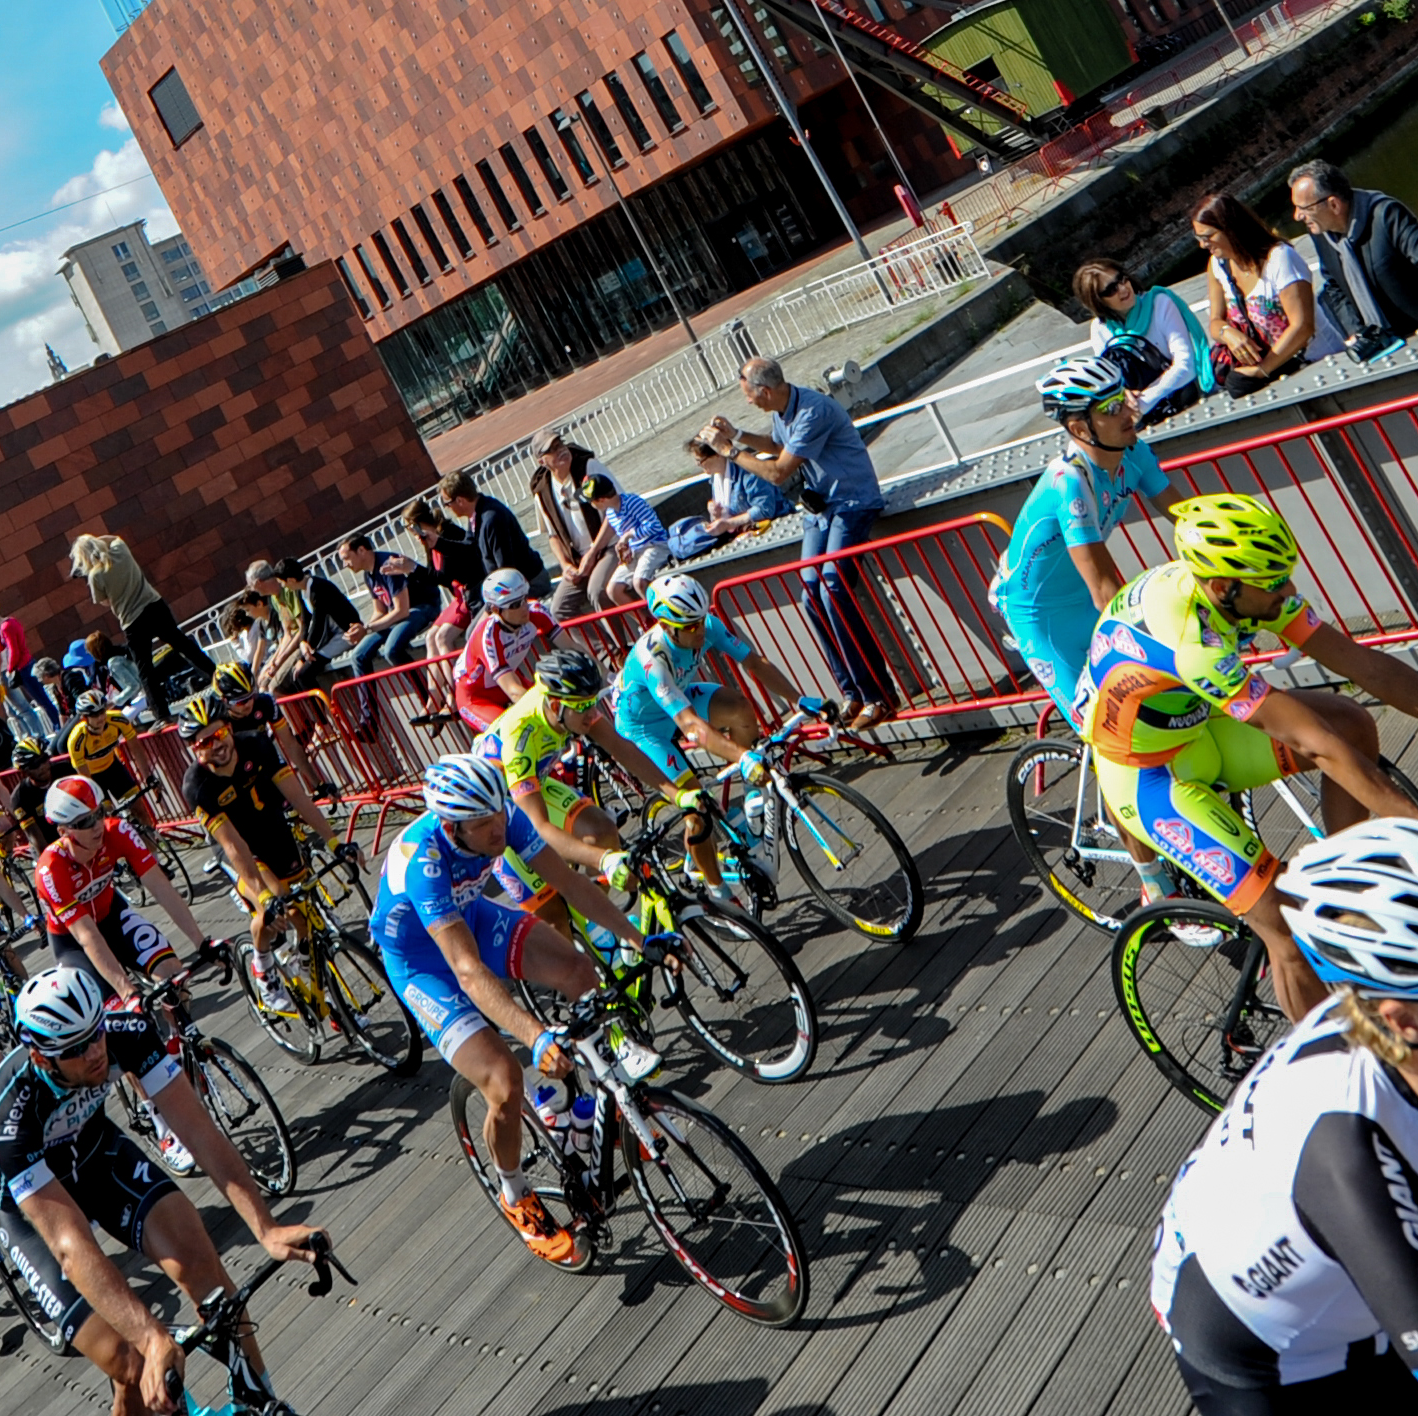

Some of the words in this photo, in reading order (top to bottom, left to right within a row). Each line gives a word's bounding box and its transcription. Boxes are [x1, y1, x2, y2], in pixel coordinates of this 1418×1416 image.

[1158, 822, 1192, 854] NERI
[1196, 854, 1234, 883] NERI
[406, 987, 447, 1022] GROUPE
[10, 1245, 64, 1320] QUICK-STEP
[1246, 1235, 1306, 1295] GIANT
